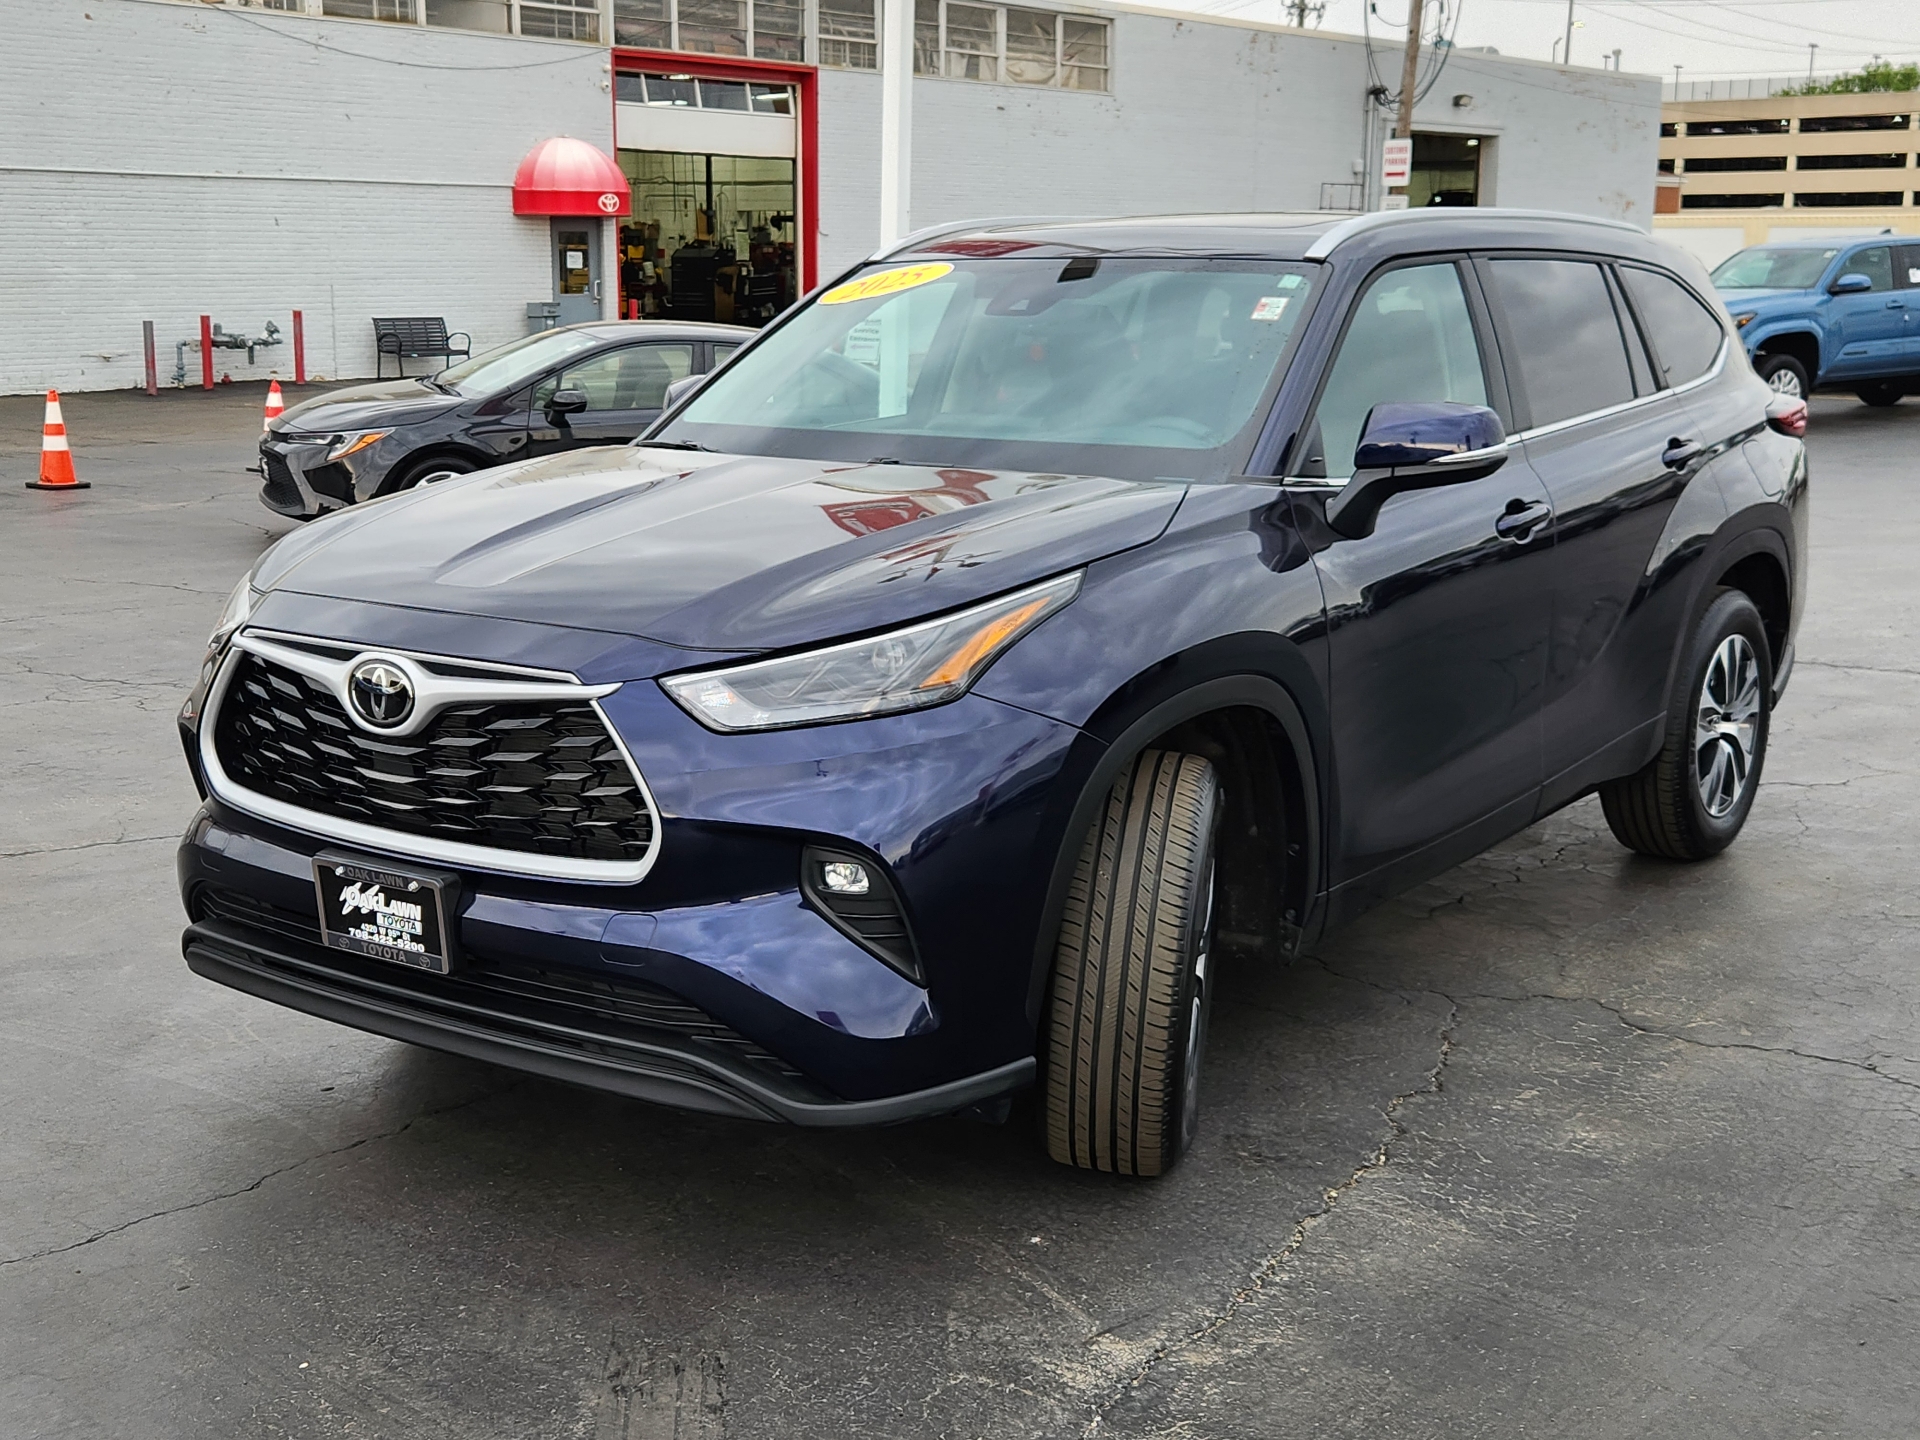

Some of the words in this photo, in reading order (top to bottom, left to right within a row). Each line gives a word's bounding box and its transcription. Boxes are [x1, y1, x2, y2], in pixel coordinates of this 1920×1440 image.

[1384, 157, 1407, 166] PARKING
[347, 866, 370, 881] OAK
[371, 871, 404, 888] LAWN
[381, 914, 417, 932] TOYOTA
[348, 927, 425, 953] 708-423-5200
[361, 942, 407, 962] TOYOTA
